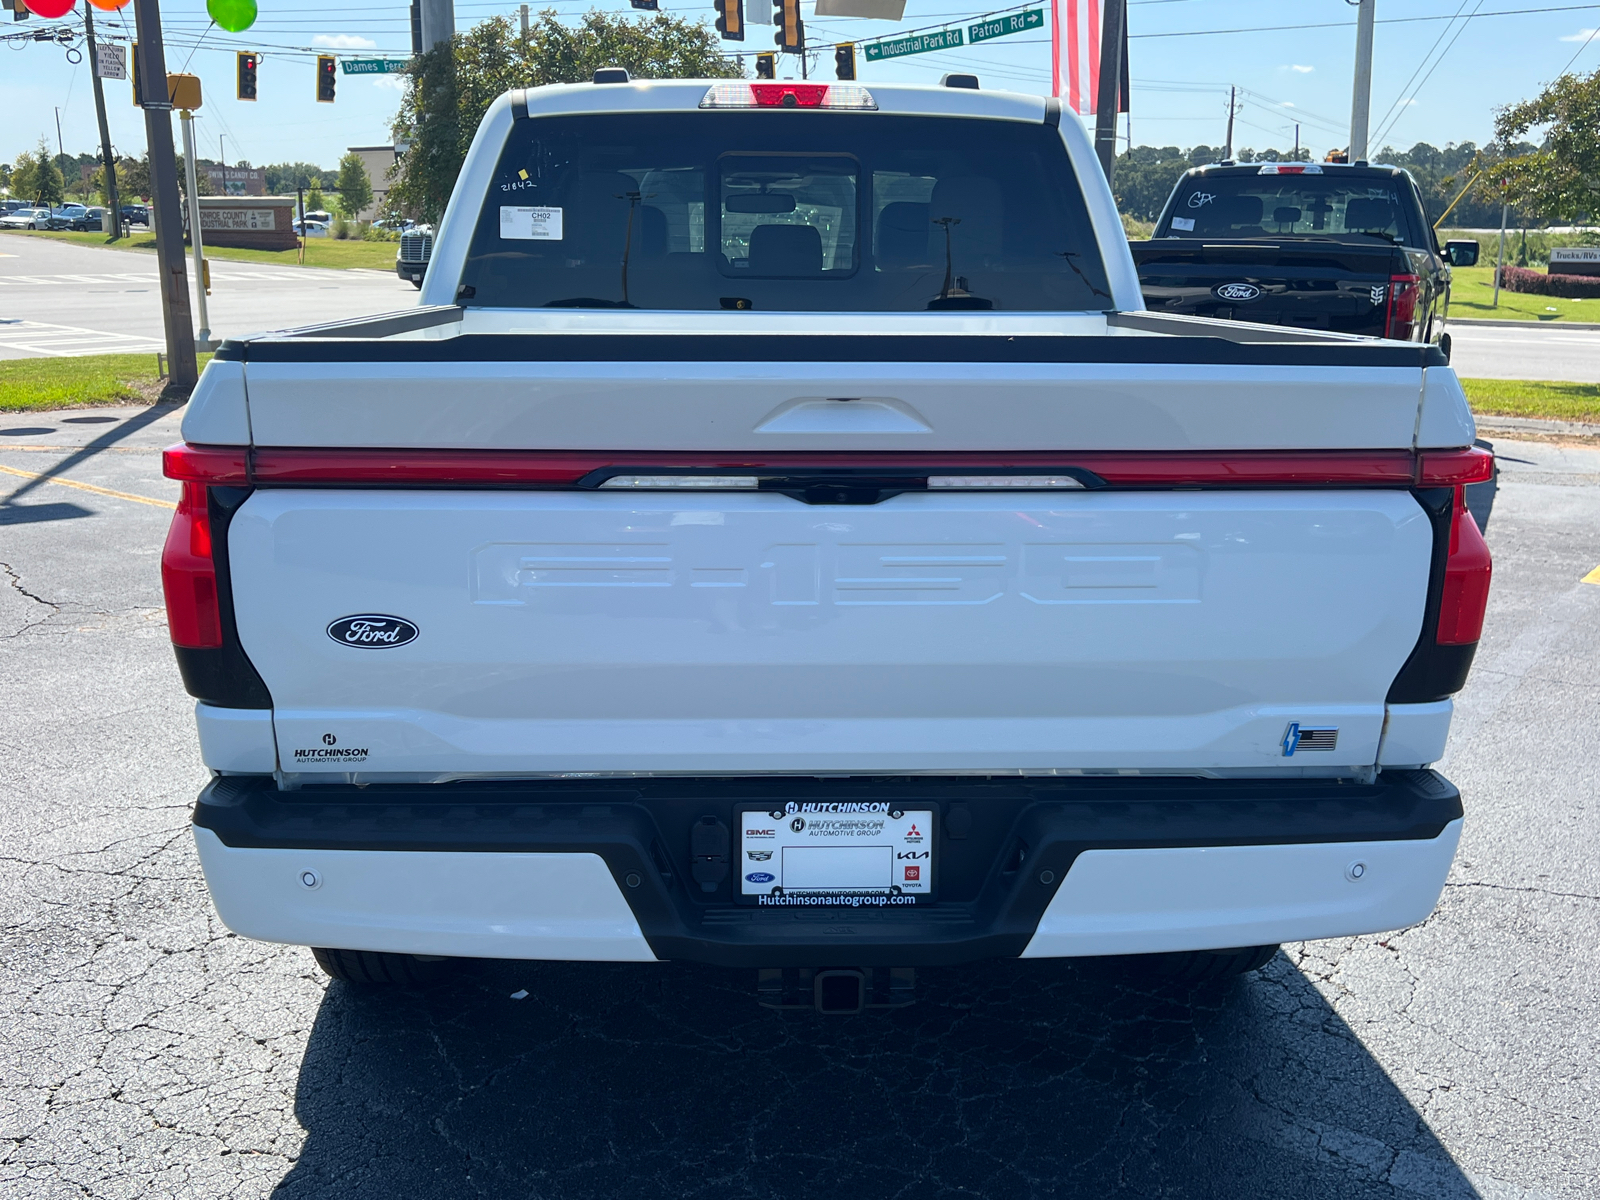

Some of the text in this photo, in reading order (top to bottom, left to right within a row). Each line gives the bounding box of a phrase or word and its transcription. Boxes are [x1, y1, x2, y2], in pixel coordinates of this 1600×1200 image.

[971, 15, 1025, 39] Patrol Rd
[881, 31, 960, 55] Industrial Park Rd
[345, 62, 378, 71] Dames
[230, 171, 248, 179] CANDY
[250, 171, 260, 179] CO.
[501, 181, 537, 191] 21842
[200, 211, 221, 220] ONROE
[222, 211, 248, 220] COUNTY
[200, 220, 249, 229] NDUSTRIAL PARK
[1224, 284, 1251, 298] Ford
[345, 620, 400, 642] Ford
[294, 748, 369, 758] HUTCHINSON
[801, 802, 890, 814] HUTCHINSON
[807, 820, 884, 831] HUTCHINSON
[897, 851, 929, 860] KIA
[758, 894, 916, 907] Hutchinsonautogroup.com
